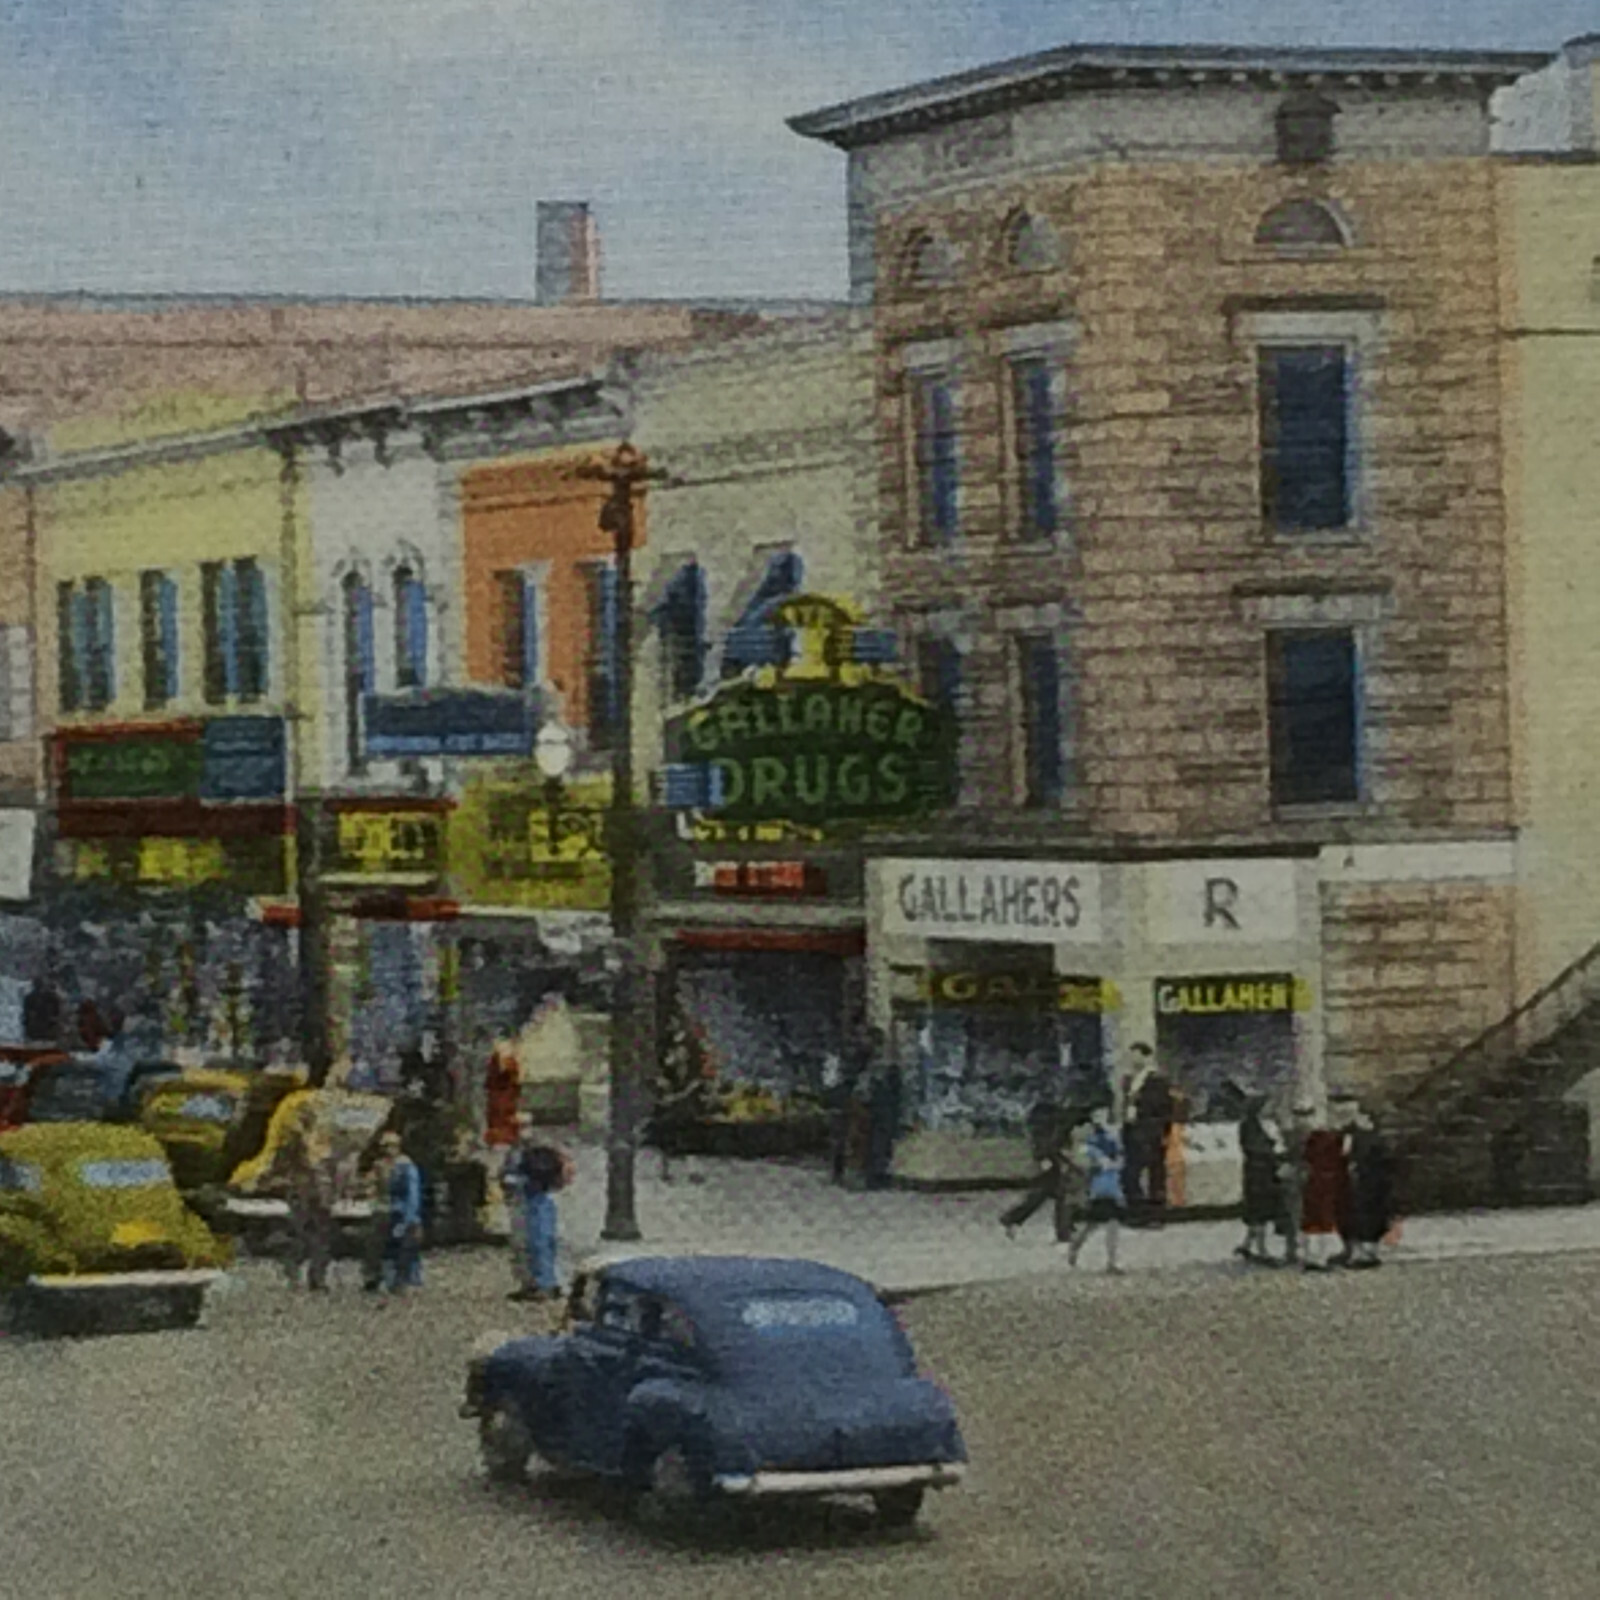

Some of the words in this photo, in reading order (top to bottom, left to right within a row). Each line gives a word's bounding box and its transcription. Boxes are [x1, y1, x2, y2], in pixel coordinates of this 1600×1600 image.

[689, 694, 922, 750] GALLAHER
[709, 753, 906, 804] DRUGS
[900, 873, 1080, 928] GALLAHERS
[1203, 876, 1241, 930] R
